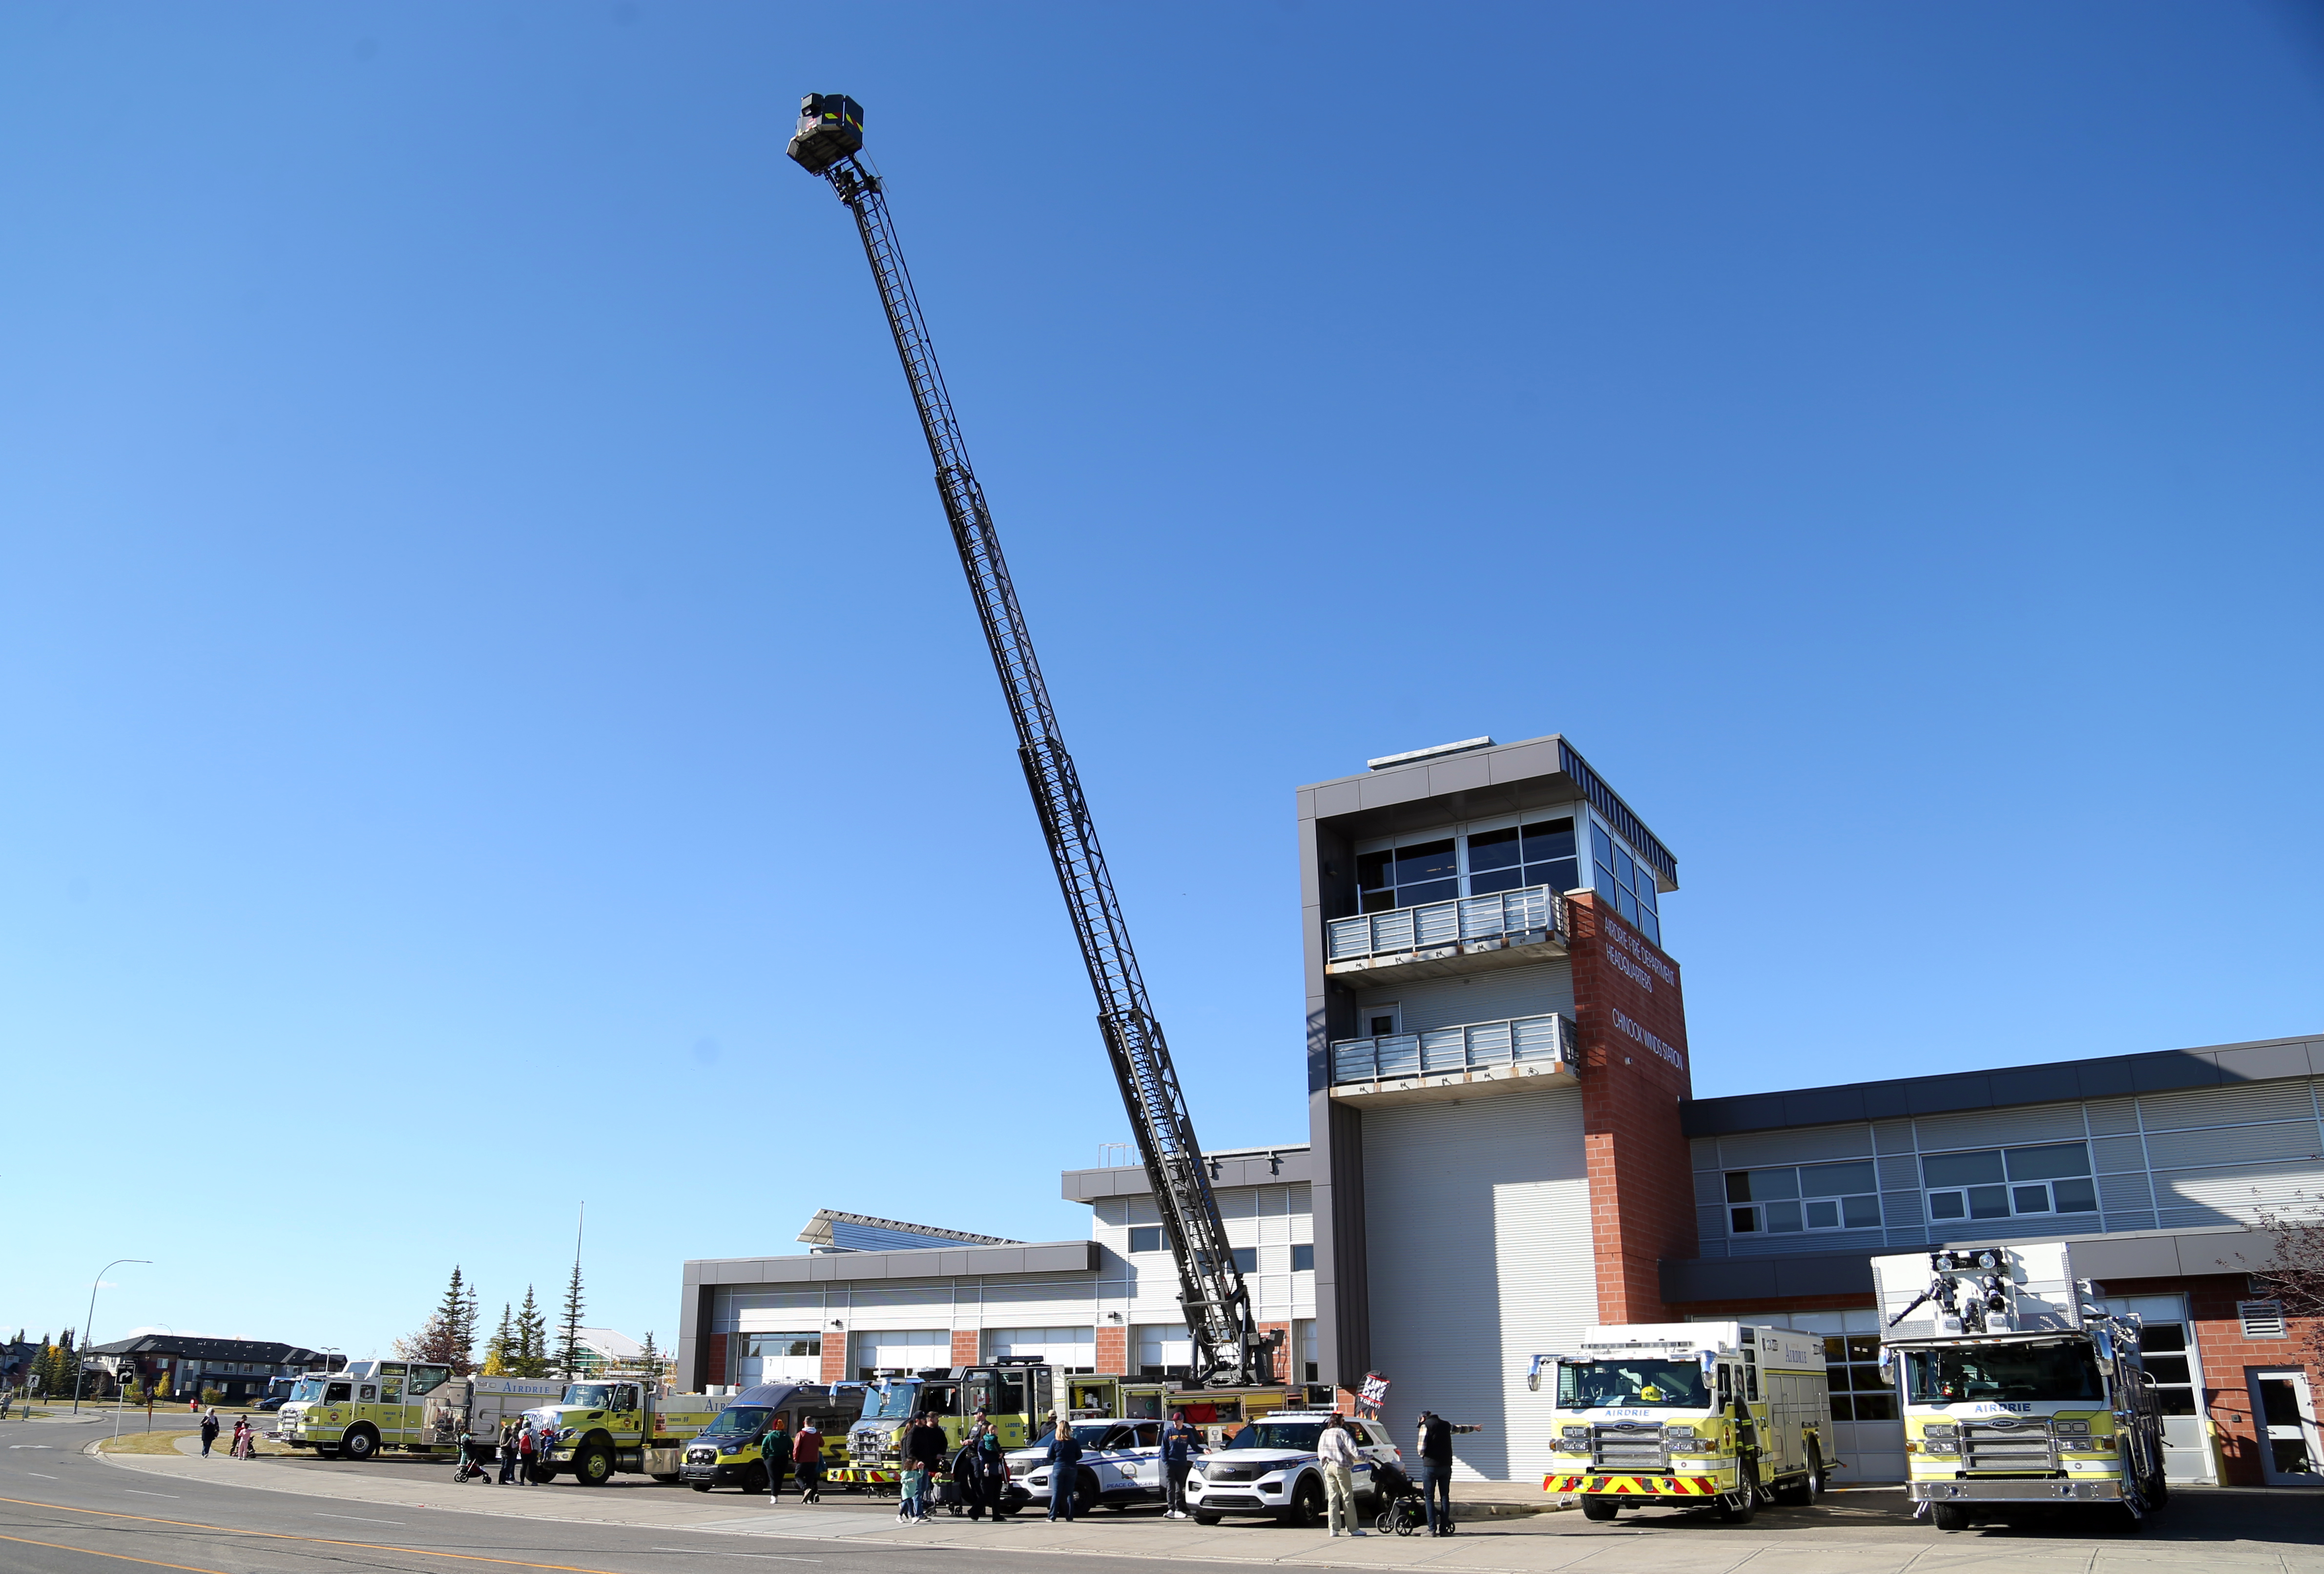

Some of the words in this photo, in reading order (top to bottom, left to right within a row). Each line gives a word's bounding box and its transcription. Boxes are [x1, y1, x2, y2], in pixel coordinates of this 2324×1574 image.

[1605, 916, 1628, 950] AIRDRIE
[1628, 935, 1641, 961] FIRE
[1641, 946, 1675, 987] DEPARTMENT
[1606, 942, 1652, 993] HEADQUARTERS
[1612, 1008, 1643, 1044] CHINOOK
[1642, 1028, 1662, 1056] WINDS
[1662, 1042, 1683, 1071] STATION
[1192, 1158, 1218, 1226] AIRDRIE
[1785, 1343, 1807, 1364] AIRDRIE
[502, 1381, 550, 1393] AIRDRIE
[1365, 1376, 1388, 1388] FIRE
[1362, 1387, 1384, 1401] DAY
[705, 1399, 729, 1411] AIR
[1360, 1396, 1381, 1409] TODAY!
[1975, 1403, 2031, 1413] AIRDRIE
